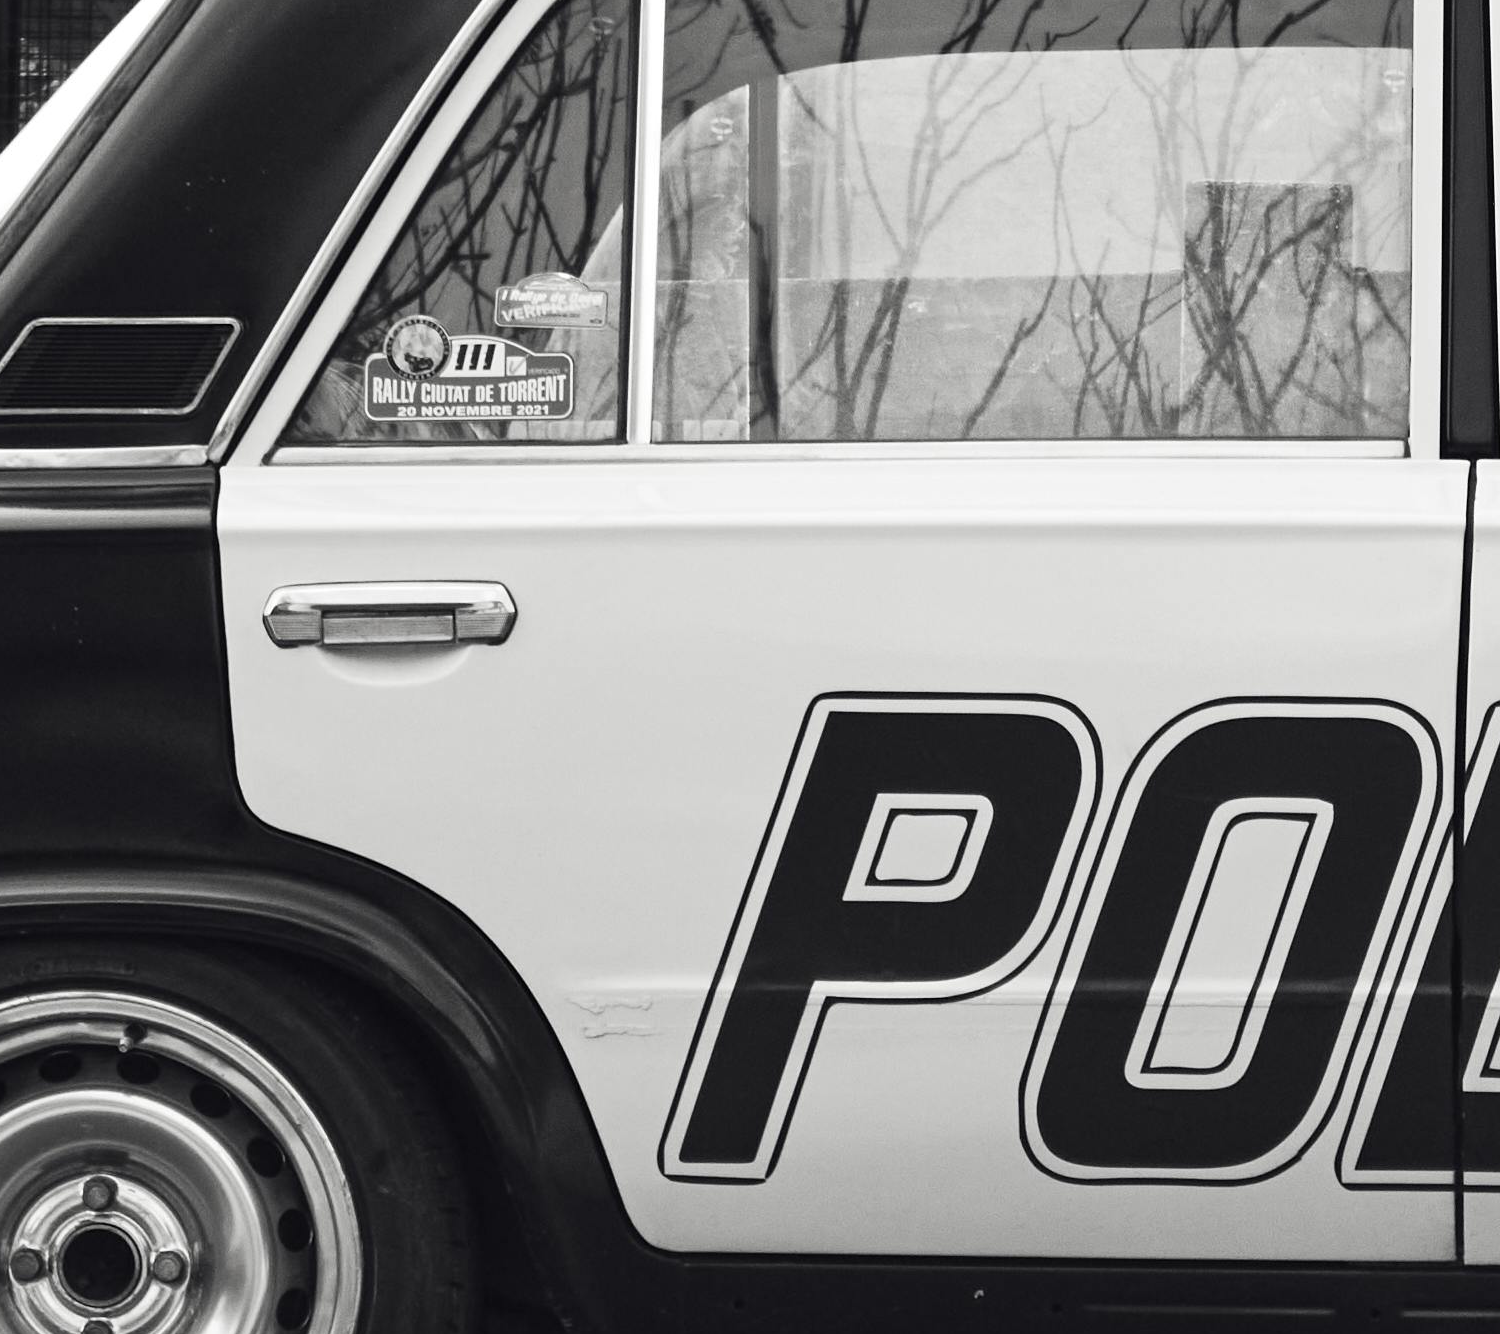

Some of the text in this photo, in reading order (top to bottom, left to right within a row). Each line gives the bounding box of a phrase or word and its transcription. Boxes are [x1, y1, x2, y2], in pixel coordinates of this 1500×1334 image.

[372, 374, 567, 404] RALLY CIUTAT DE TORRENT
[397, 404, 549, 417] 20 NOVEMBRE 2021
